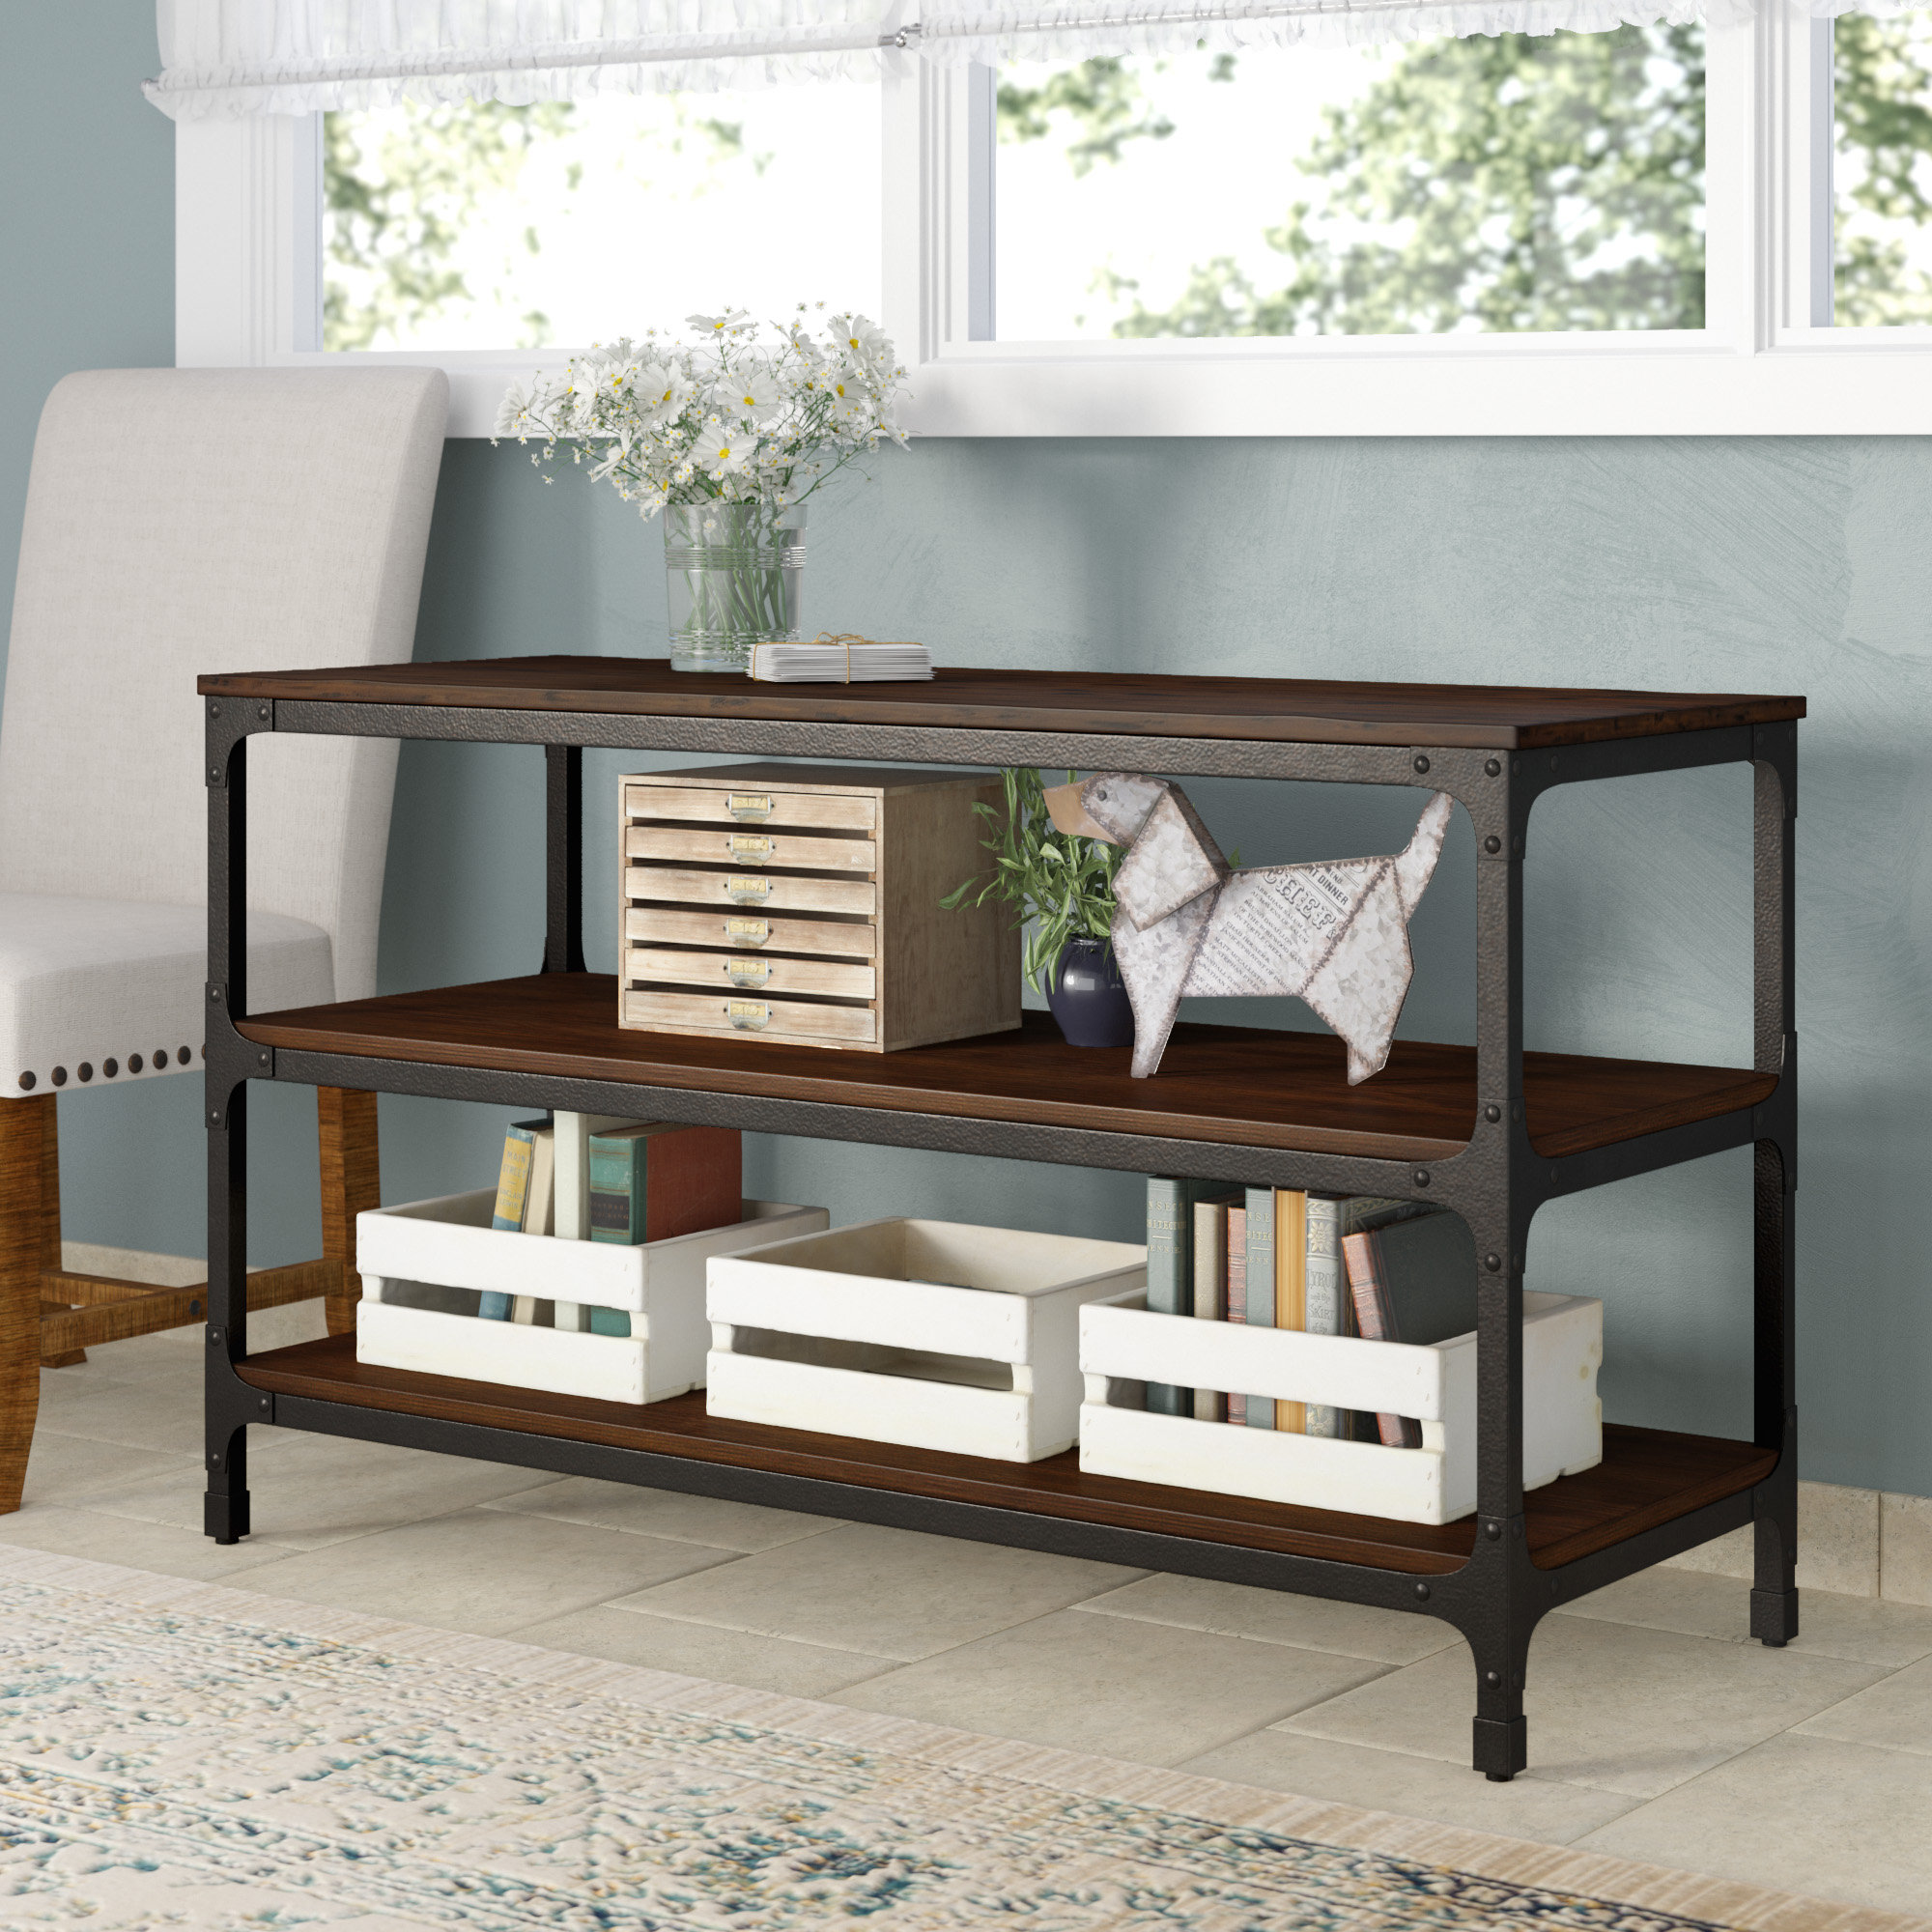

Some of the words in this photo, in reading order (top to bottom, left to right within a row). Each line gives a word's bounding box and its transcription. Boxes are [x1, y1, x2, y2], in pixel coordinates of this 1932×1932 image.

[1316, 873, 1350, 906] DINNER
[506, 1150, 526, 1165] MAIN
[501, 1163, 527, 1180] STREET
